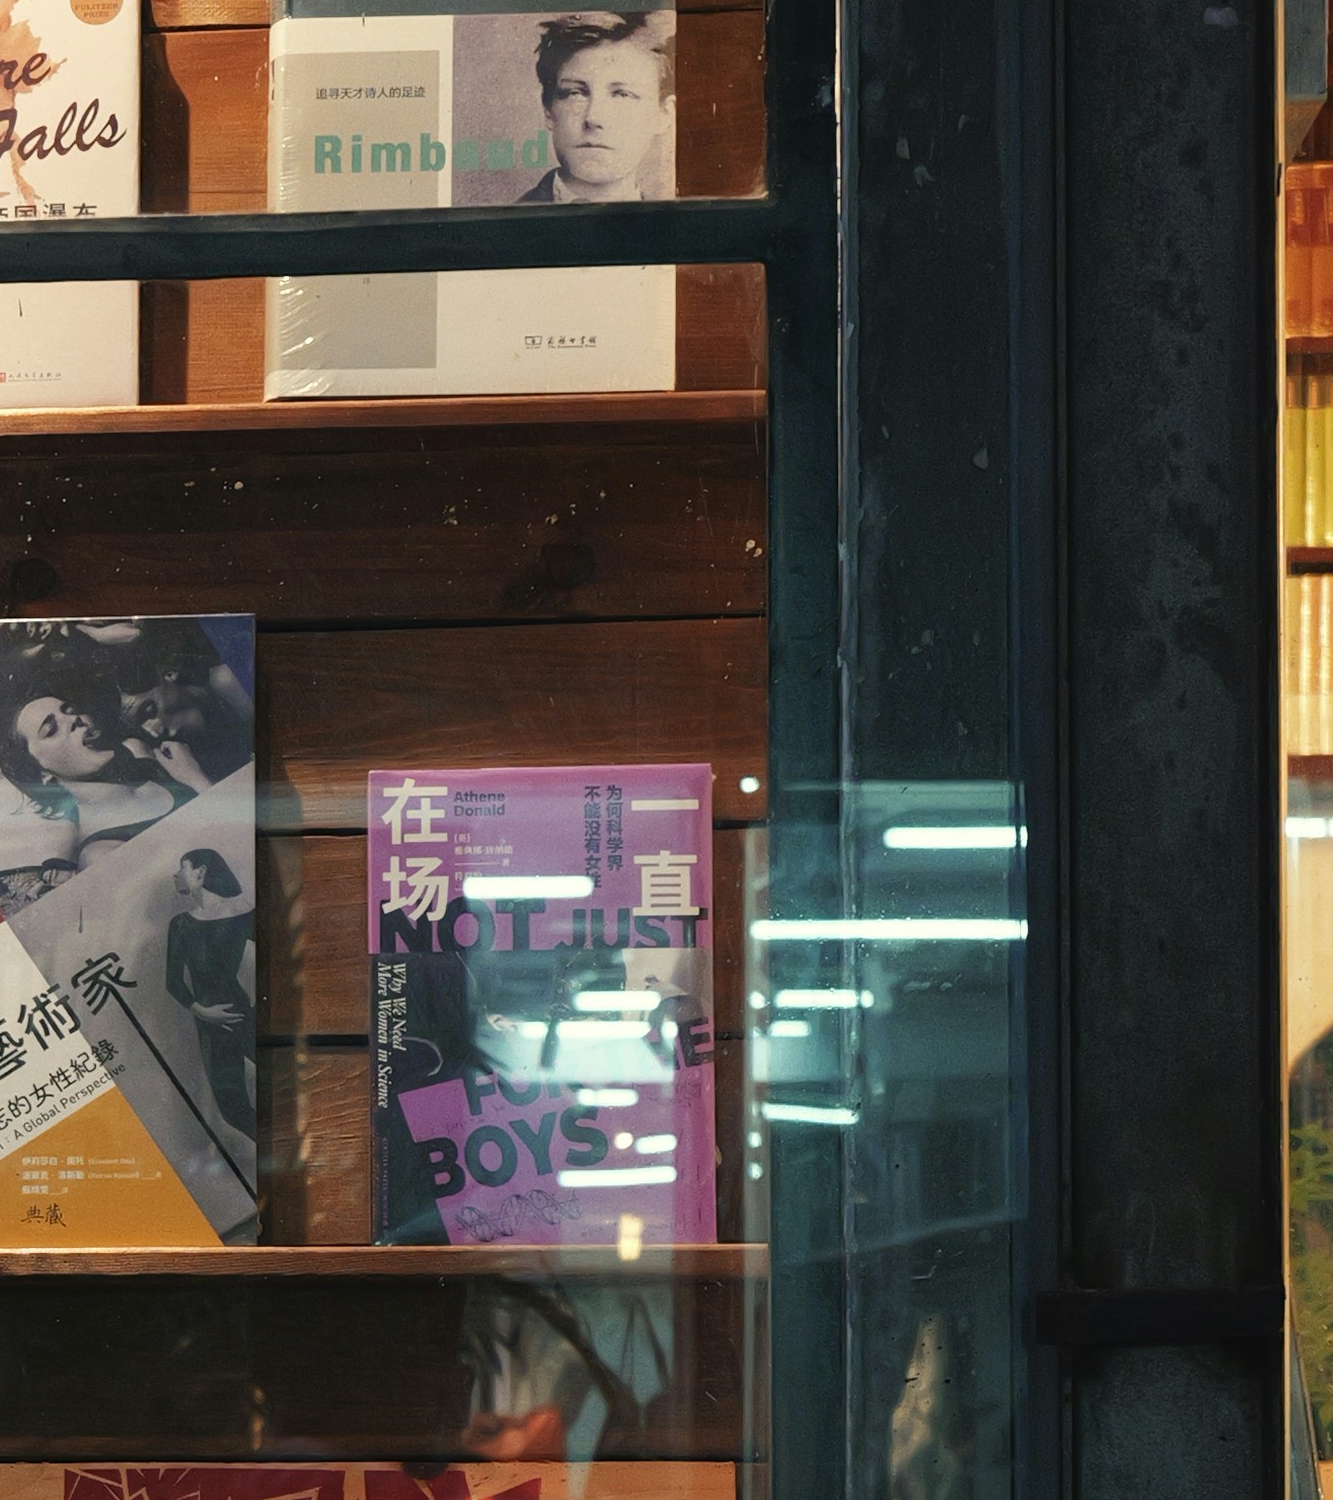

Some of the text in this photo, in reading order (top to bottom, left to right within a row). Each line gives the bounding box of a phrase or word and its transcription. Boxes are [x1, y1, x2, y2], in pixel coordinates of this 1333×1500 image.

[313, 128, 551, 175] Rimbaud
[453, 790, 506, 804] Athene
[453, 804, 506, 817] Donald
[605, 784, 624, 872] 为何科学界
[381, 778, 449, 922] 在场
[630, 797, 701, 917] 一直
[378, 900, 709, 955] NOT JUST
[377, 961, 393, 1109] More Women in Science
[387, 962, 408, 1052] Why We Need
[22, 1104, 62, 1137] Global
[59, 1061, 127, 1112] Perspective
[427, 1108, 610, 1199] BOYS
